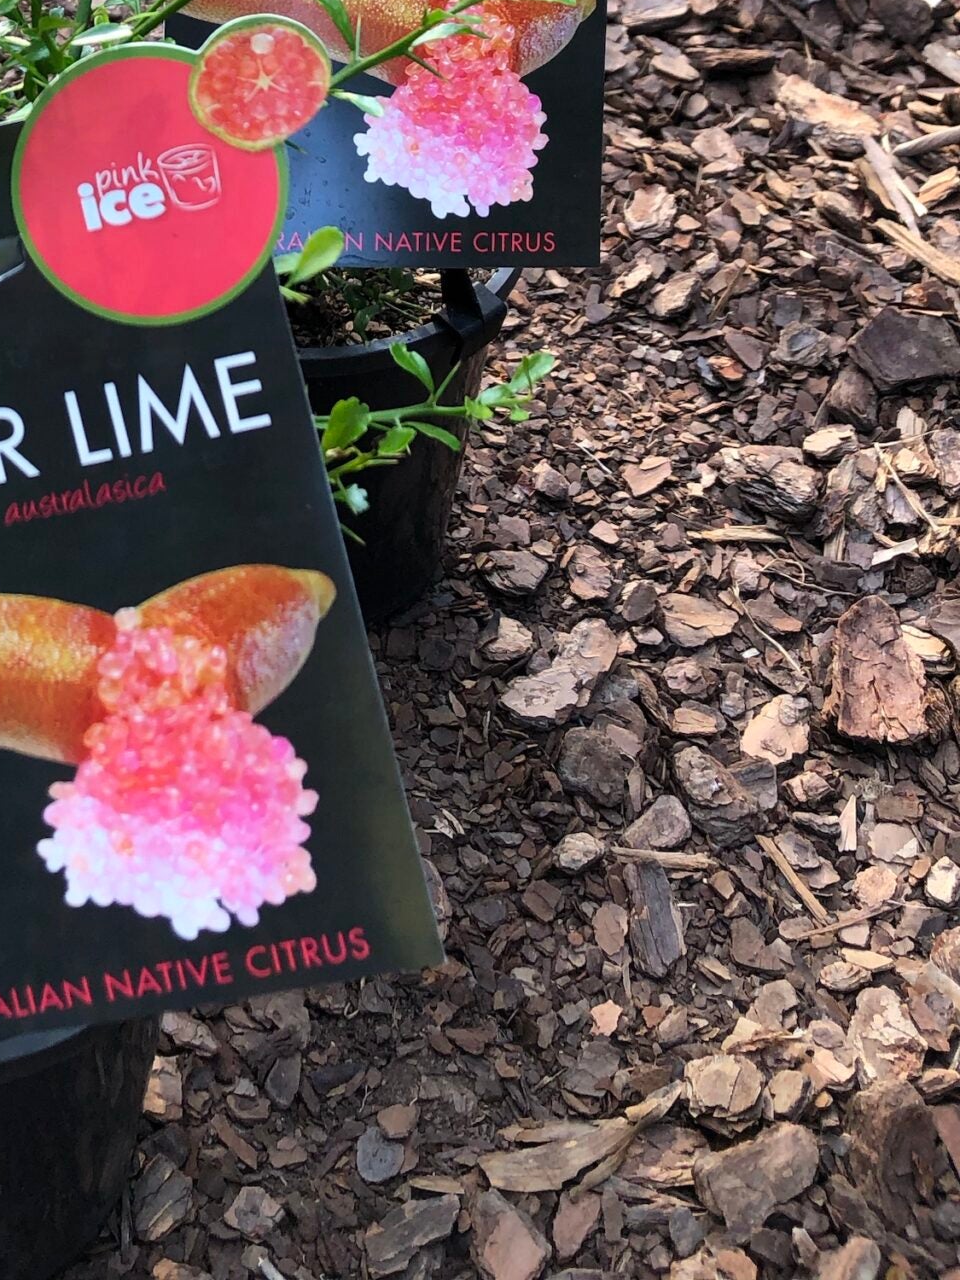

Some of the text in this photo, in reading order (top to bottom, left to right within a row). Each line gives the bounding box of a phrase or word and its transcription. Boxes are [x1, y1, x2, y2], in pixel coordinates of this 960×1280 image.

[96, 151, 159, 197] pink
[77, 182, 166, 232] ice
[375, 231, 462, 252] NATIVE
[473, 231, 556, 252] CITRUS
[63, 351, 272, 467] LIME
[3, 470, 167, 527] australasica
[103, 951, 233, 1002] NATIVE
[245, 927, 371, 978] CITRUS
